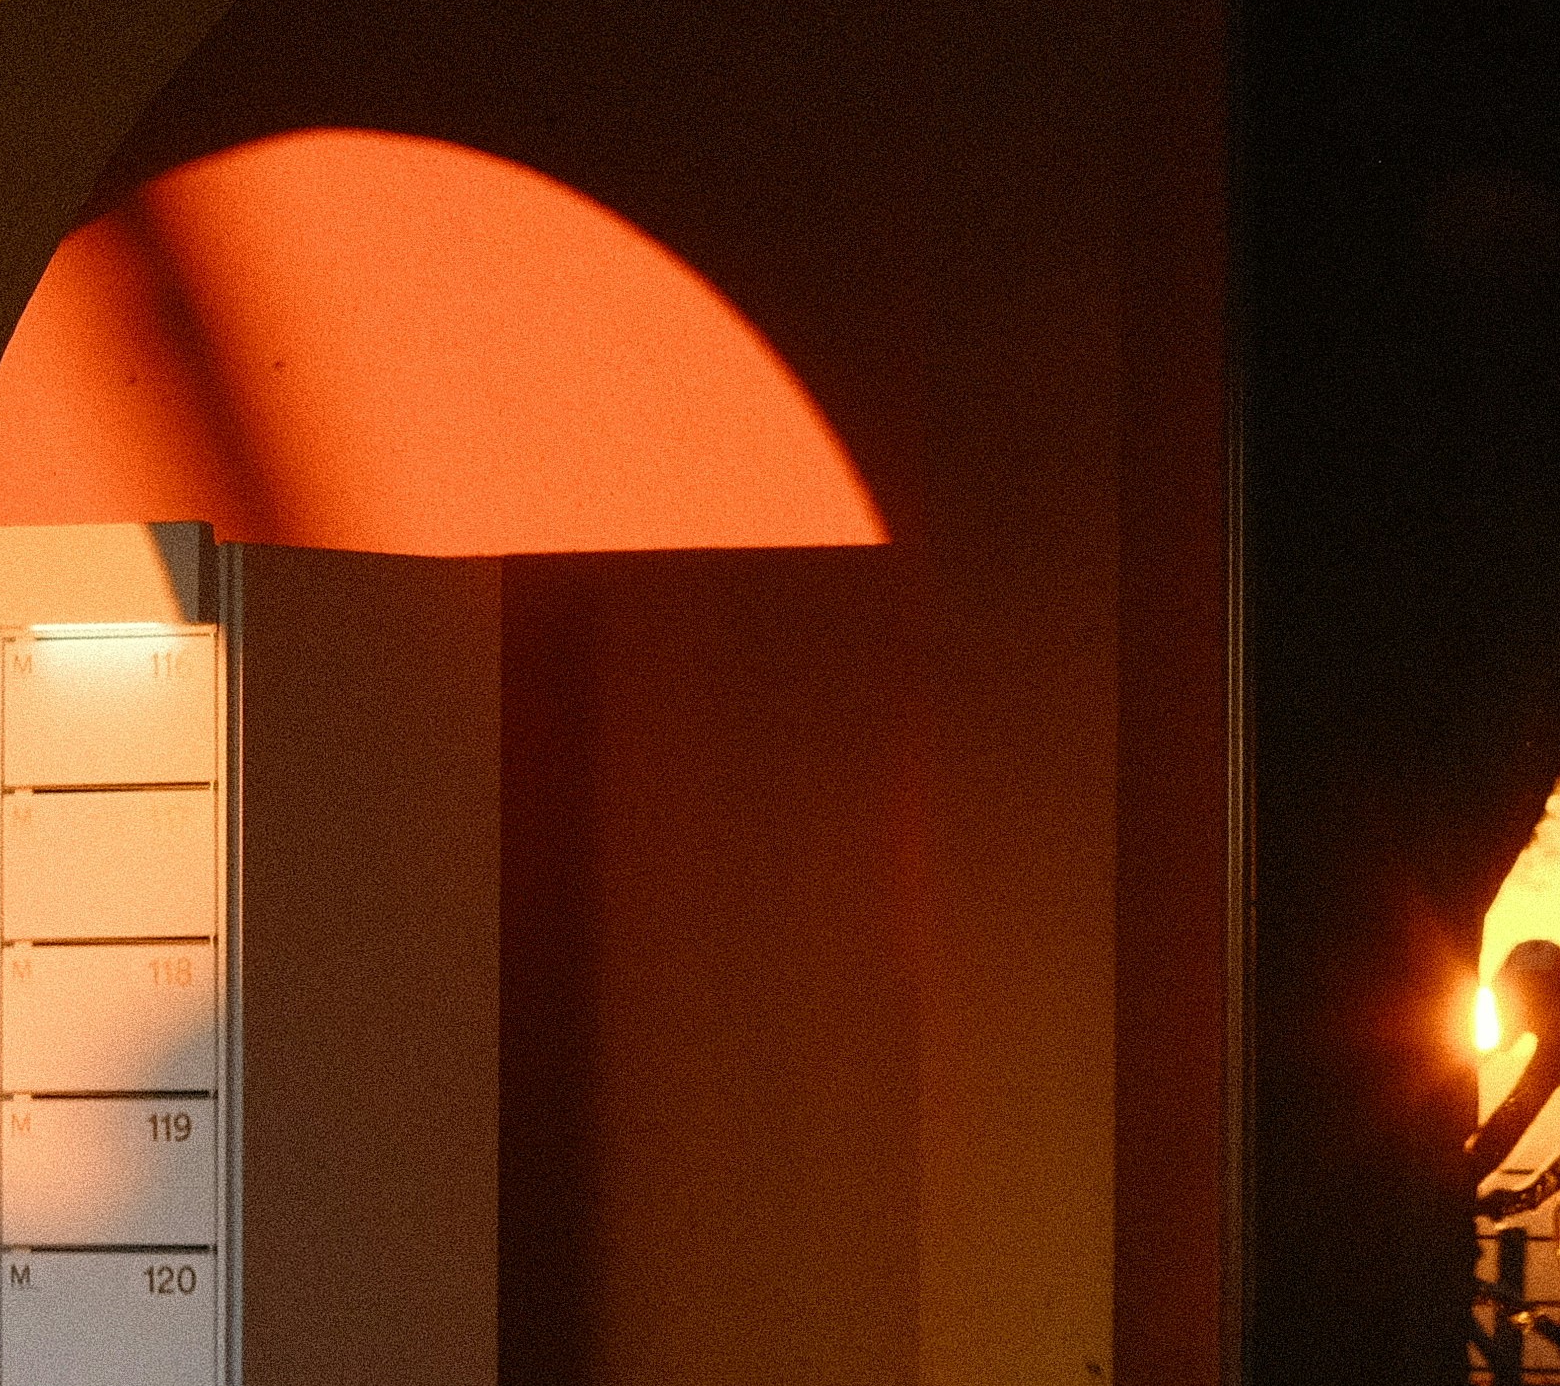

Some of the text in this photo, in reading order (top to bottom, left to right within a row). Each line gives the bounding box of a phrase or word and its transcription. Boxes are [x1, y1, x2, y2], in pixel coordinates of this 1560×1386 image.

[13, 656, 33, 676] M
[12, 959, 32, 980] M
[148, 957, 192, 986] 118
[11, 1113, 31, 1133] M
[146, 1113, 192, 1142] 119
[10, 1265, 31, 1287] M
[144, 1266, 197, 1294] 120
